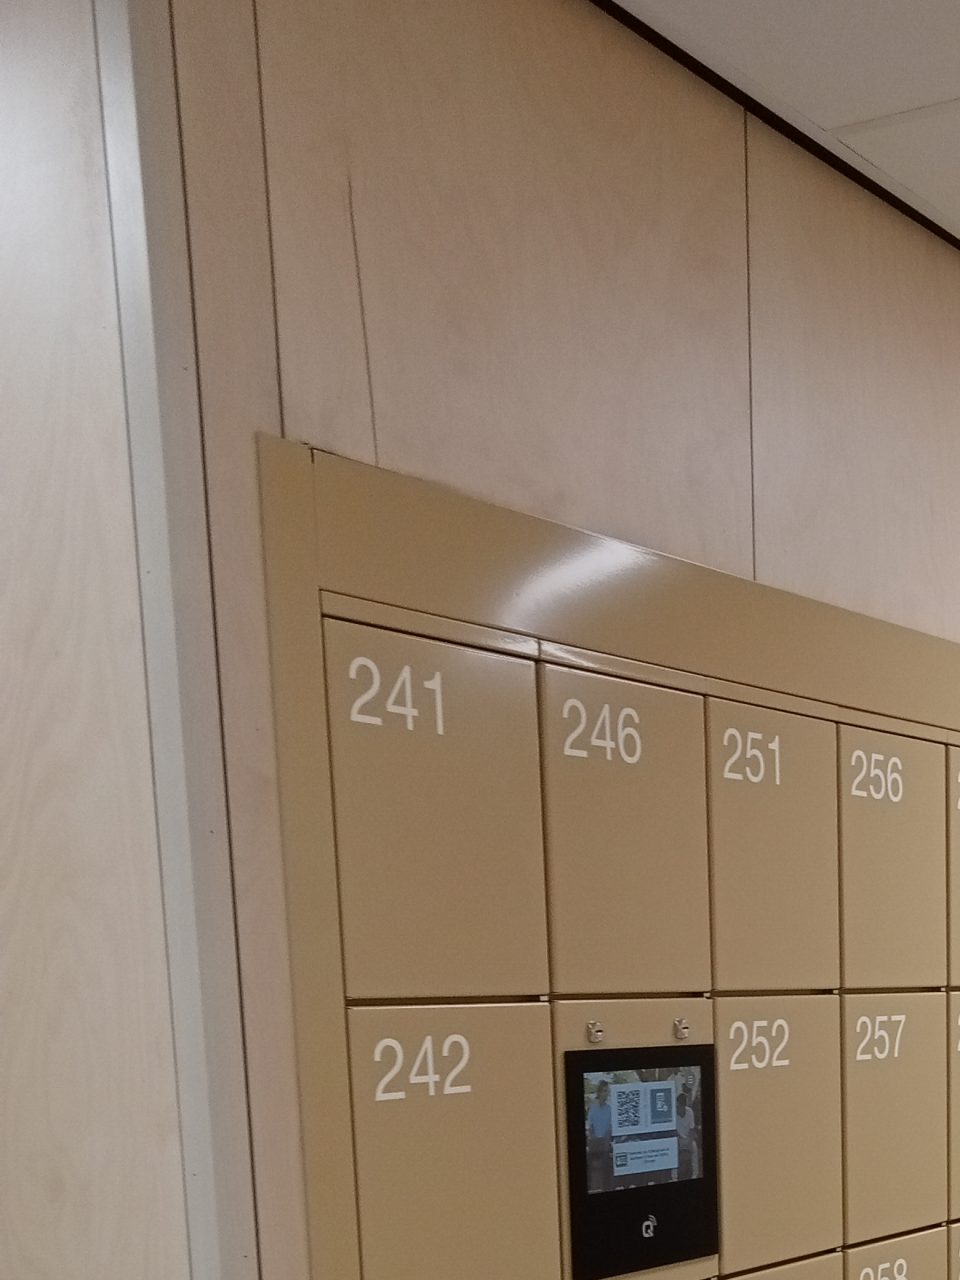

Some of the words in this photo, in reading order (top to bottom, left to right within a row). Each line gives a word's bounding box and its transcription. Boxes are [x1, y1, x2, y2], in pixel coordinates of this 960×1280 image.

[349, 656, 444, 737] 241
[563, 698, 642, 764] 246
[723, 727, 784, 786] 251
[851, 749, 903, 802] 256
[729, 1018, 790, 1071] 252
[856, 1014, 906, 1061] 257
[373, 1034, 472, 1101] 242
